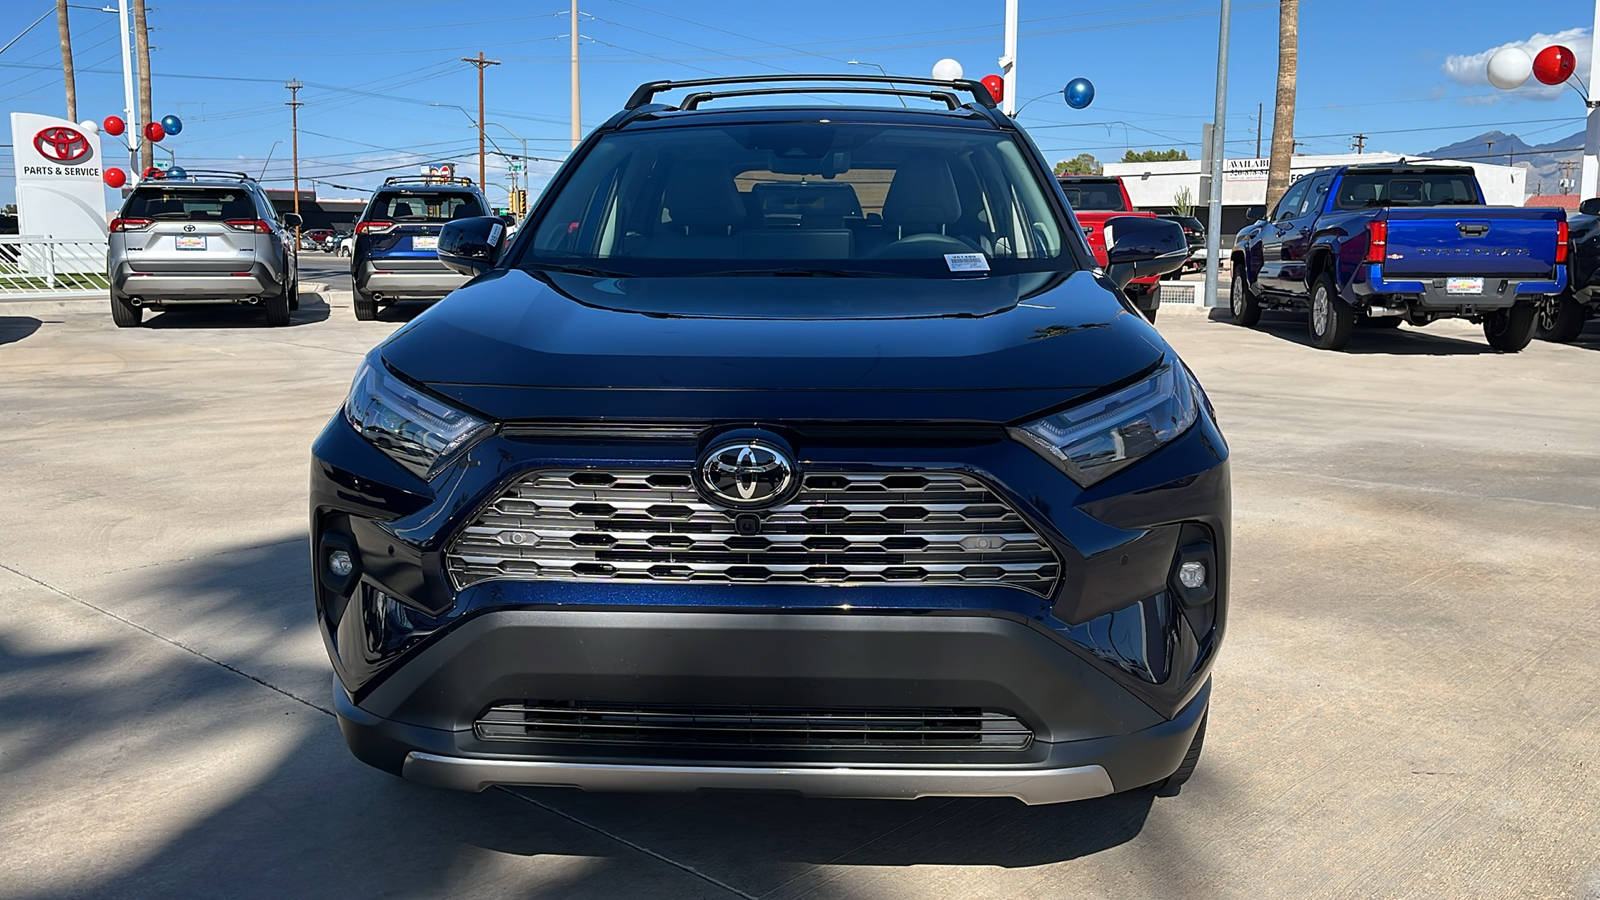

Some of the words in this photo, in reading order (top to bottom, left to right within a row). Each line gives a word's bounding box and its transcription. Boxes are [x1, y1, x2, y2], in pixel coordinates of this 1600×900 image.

[23, 166, 53, 175] PARTS
[55, 166, 62, 175] &
[64, 167, 100, 177] SERVICE
